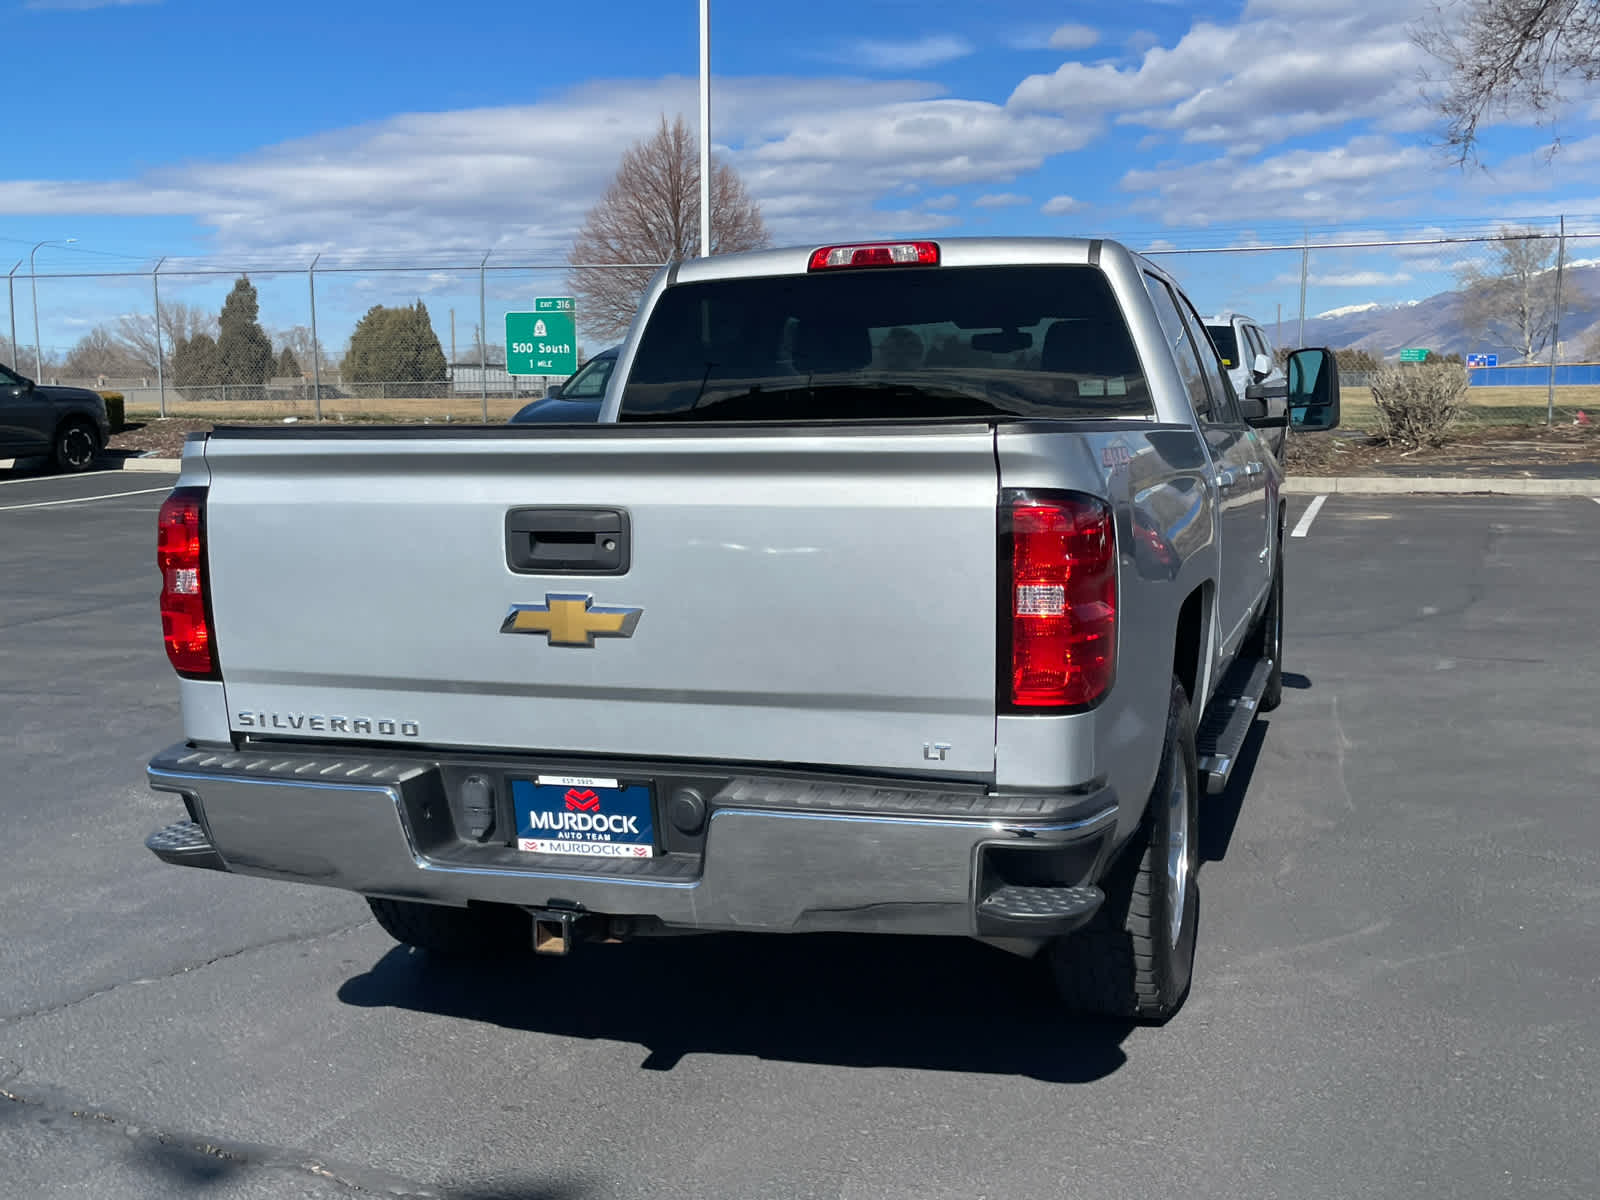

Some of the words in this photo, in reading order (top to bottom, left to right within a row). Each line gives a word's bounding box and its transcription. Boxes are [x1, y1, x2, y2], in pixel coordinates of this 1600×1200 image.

[556, 300, 570, 309] 316
[512, 342, 533, 353] 500
[538, 342, 570, 353] South
[529, 359, 534, 368] 1
[537, 360, 553, 368] MILE
[238, 711, 419, 737] SILVERADO
[923, 742, 952, 761] LT
[529, 810, 639, 834] MURDOCK
[557, 831, 582, 840] AUTO
[586, 832, 611, 841] TEAM
[549, 842, 622, 856] MURDOCK
